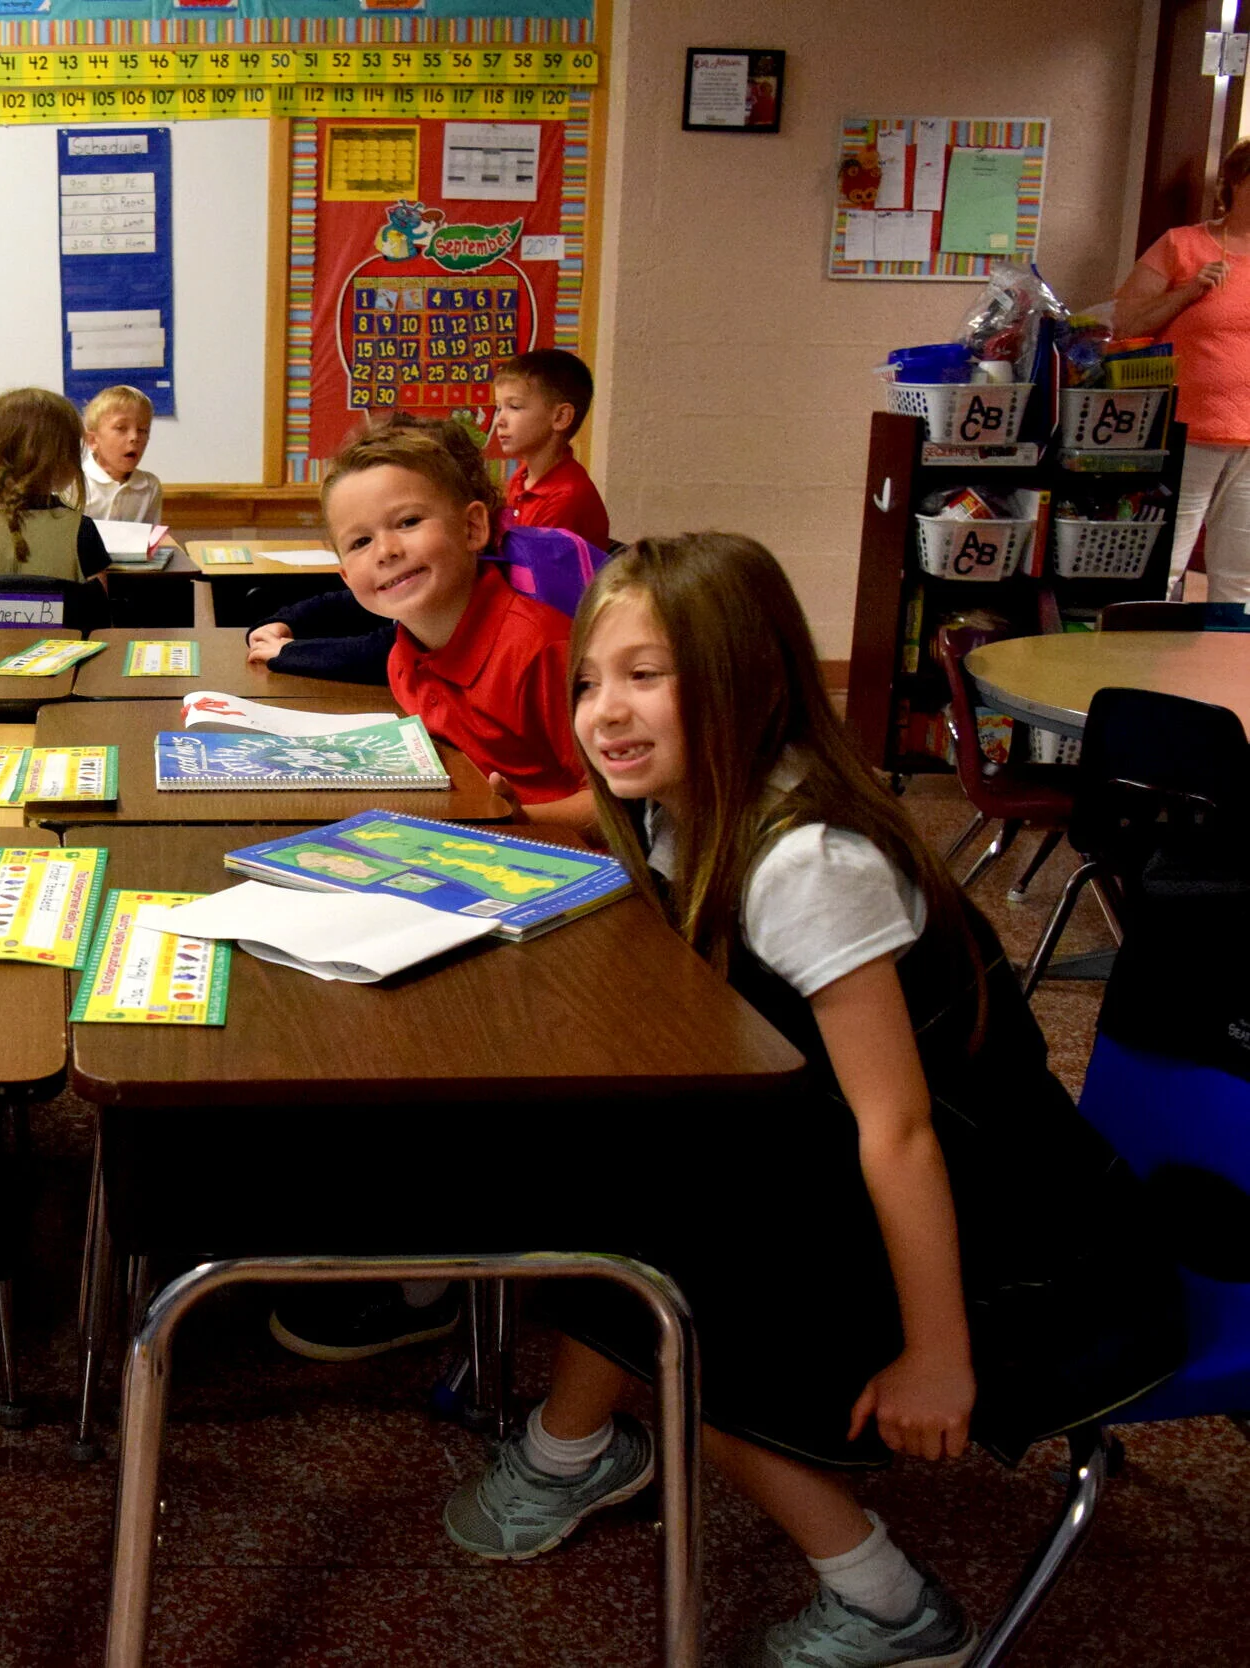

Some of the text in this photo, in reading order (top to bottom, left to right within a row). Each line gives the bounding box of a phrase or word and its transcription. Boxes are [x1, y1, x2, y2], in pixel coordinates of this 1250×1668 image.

[1, 55, 15, 70] 41
[29, 55, 48, 70] 42
[59, 55, 78, 70] 43
[89, 55, 109, 69] 44
[119, 54, 139, 69] 45
[149, 54, 169, 69] 46
[179, 54, 199, 68] 47
[210, 53, 230, 69] 48
[239, 53, 260, 68] 49
[271, 53, 290, 68] 50
[304, 52, 318, 67] 51
[332, 52, 351, 68] 52
[362, 52, 382, 68] 53
[392, 52, 412, 68] 54
[72, 136, 142, 155] Schedule
[435, 229, 513, 258] September
[523, 238, 559, 258] 2019
[361, 291, 511, 306] 1 4 5 6 7
[359, 316, 513, 334] 8 9 10 11 12 13 14
[358, 340, 513, 358] 15 16 17 18 19 20 21
[354, 364, 489, 381] 22 23 24 25 26 27
[353, 389, 394, 405] 29 30
[41, 600, 54, 624] B
